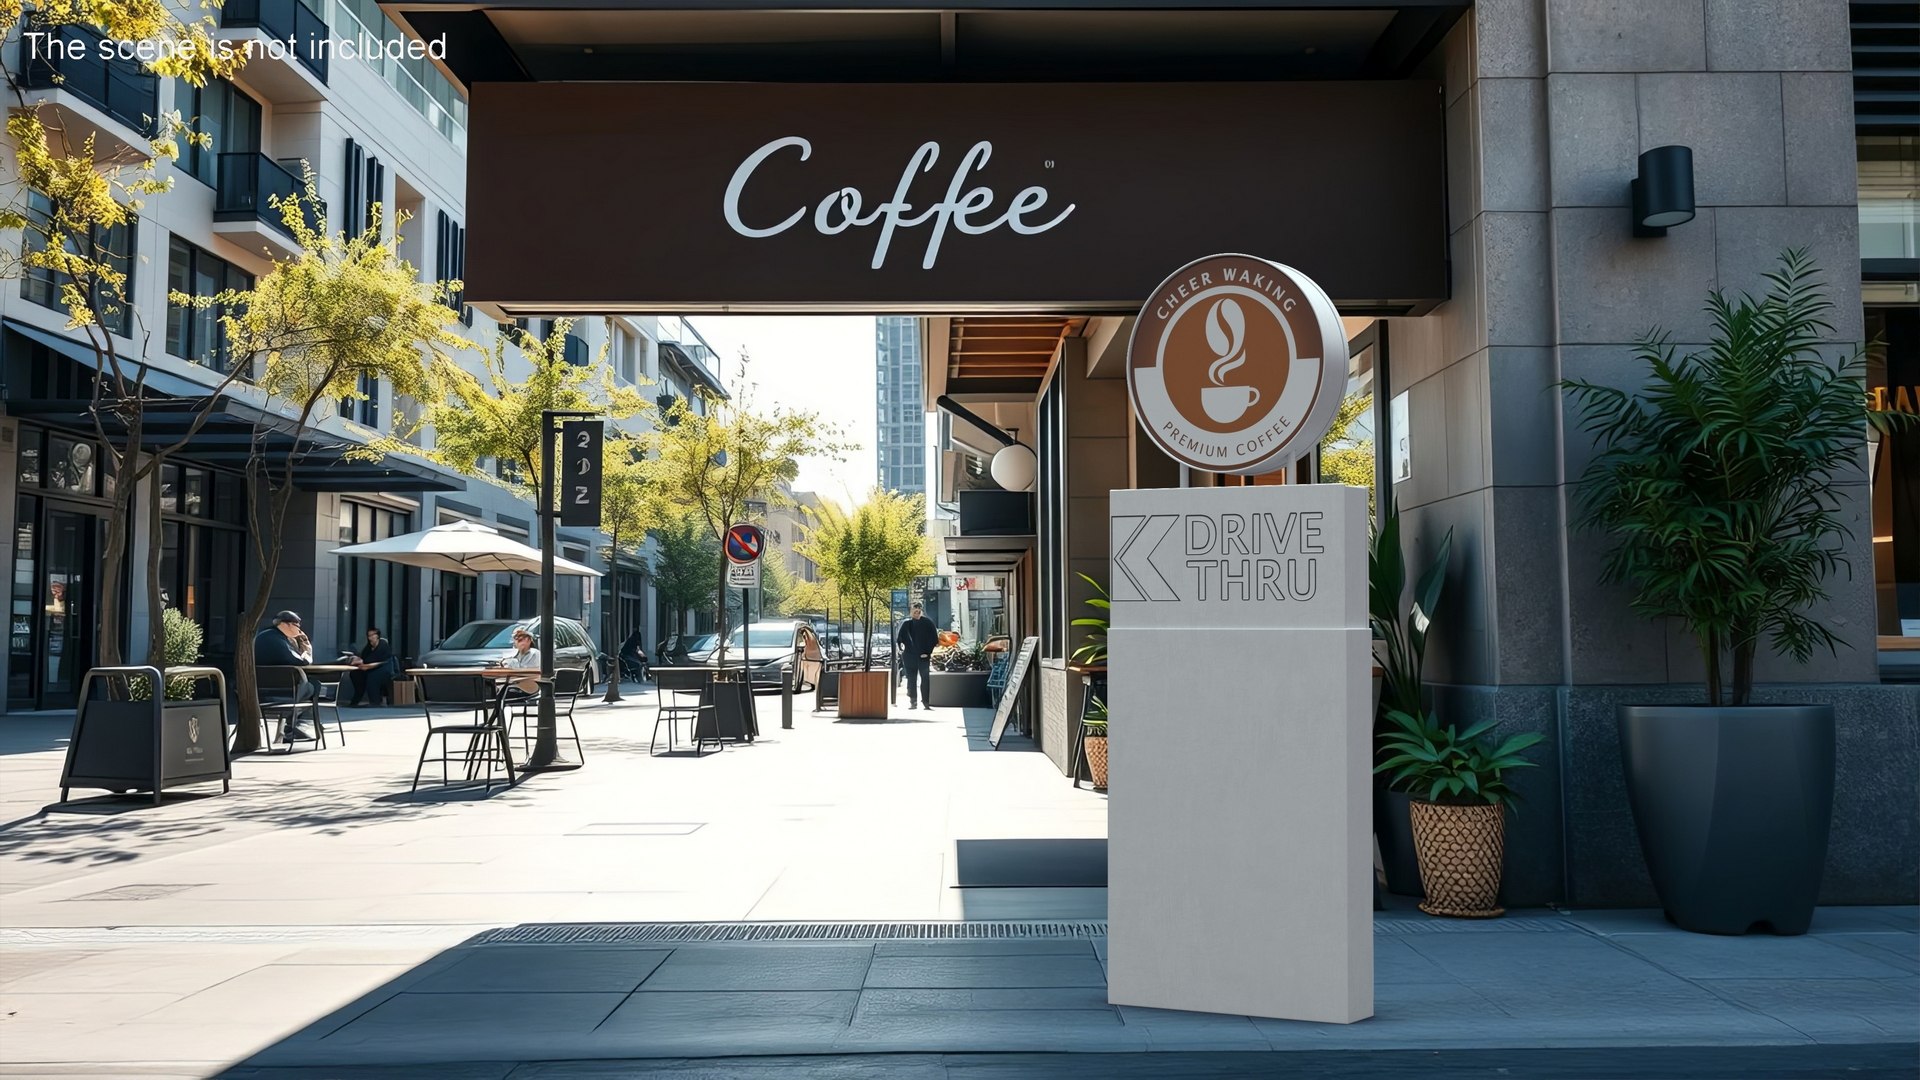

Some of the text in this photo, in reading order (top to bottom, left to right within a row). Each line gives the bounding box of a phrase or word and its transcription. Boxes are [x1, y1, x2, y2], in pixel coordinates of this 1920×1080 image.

[723, 136, 1076, 270] Coffee
[1156, 267, 1297, 321] CHEER WAKING
[1163, 415, 1291, 458] PREMIUM COFFEE
[1185, 511, 1325, 556] DRIVE
[1186, 558, 1318, 602] THRU
